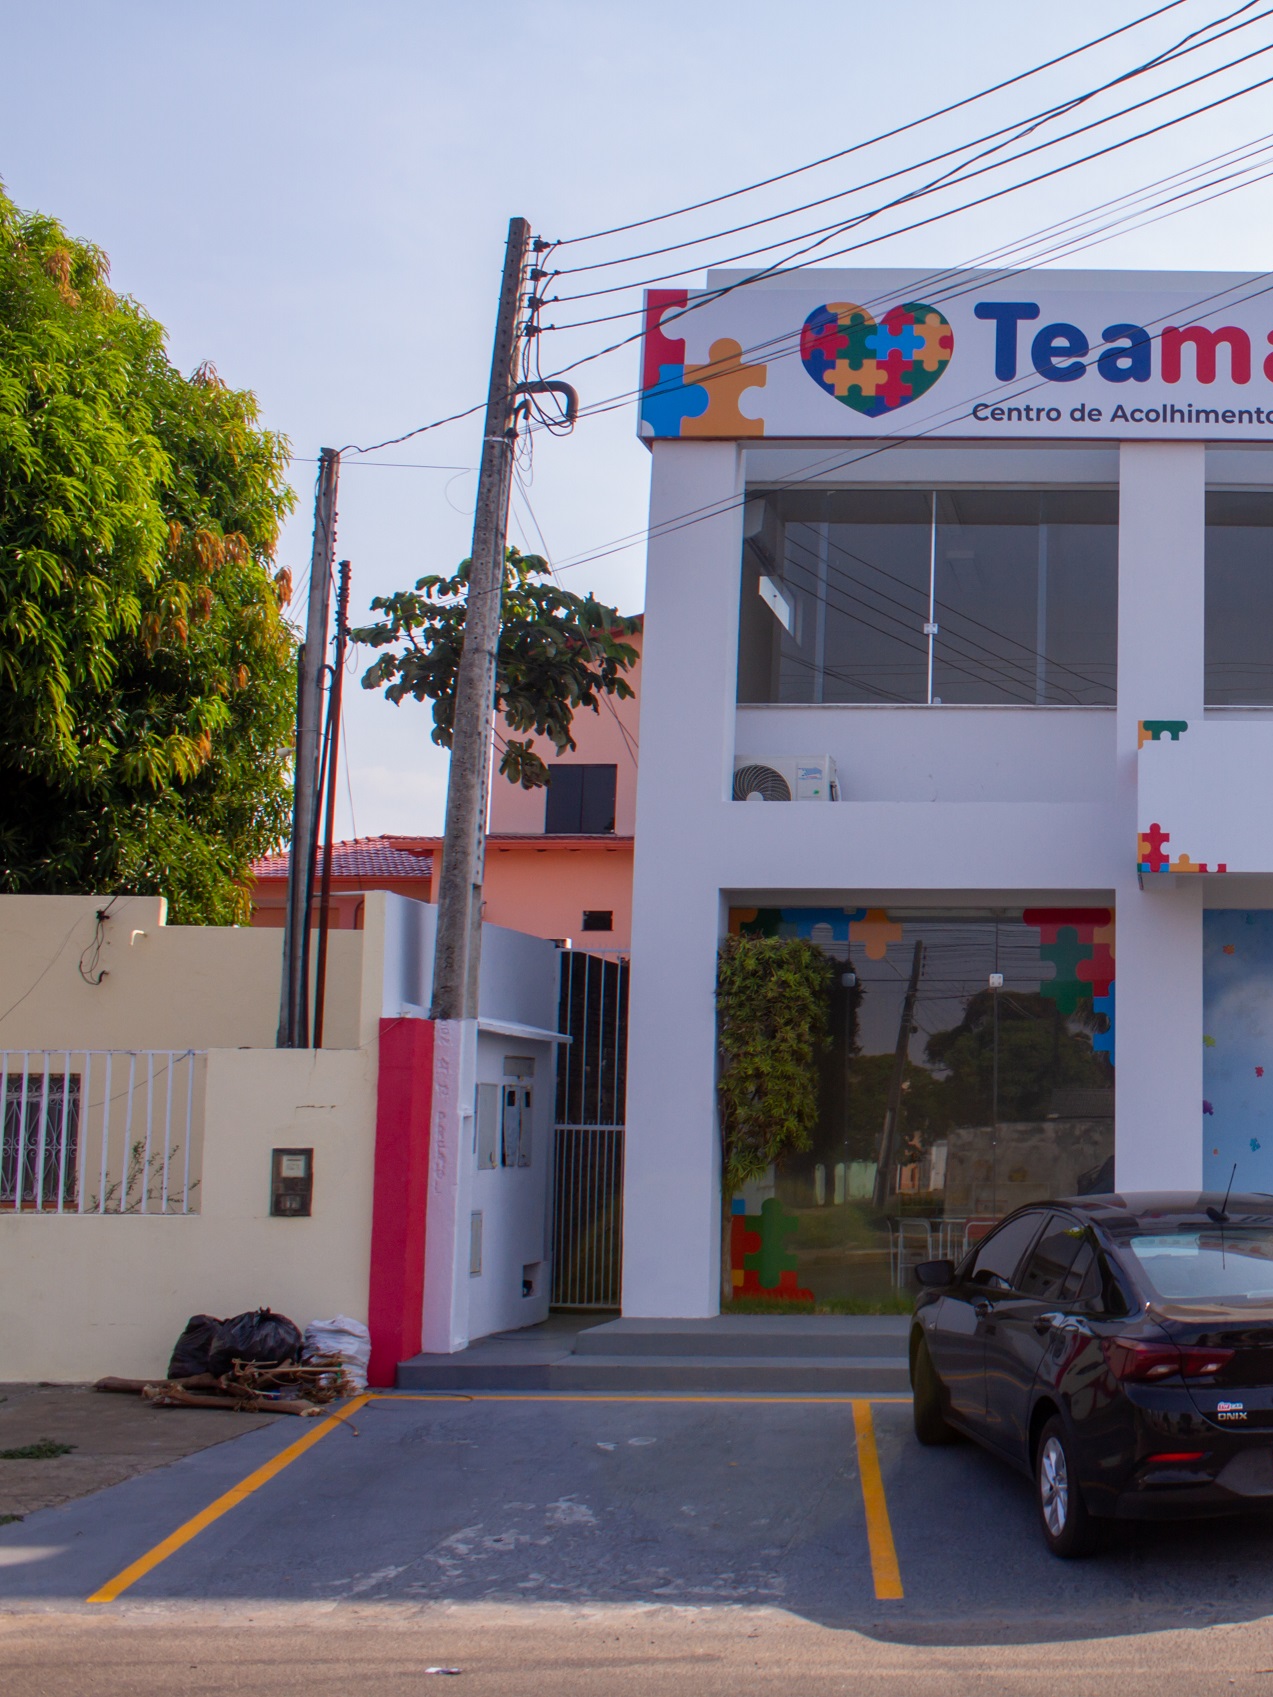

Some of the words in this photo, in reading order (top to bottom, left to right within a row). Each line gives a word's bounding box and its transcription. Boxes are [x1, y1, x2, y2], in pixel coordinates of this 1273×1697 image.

[972, 403, 1062, 422] Centro
[1070, 403, 1102, 422] de
[1218, 1412, 1248, 1420] ONIX
